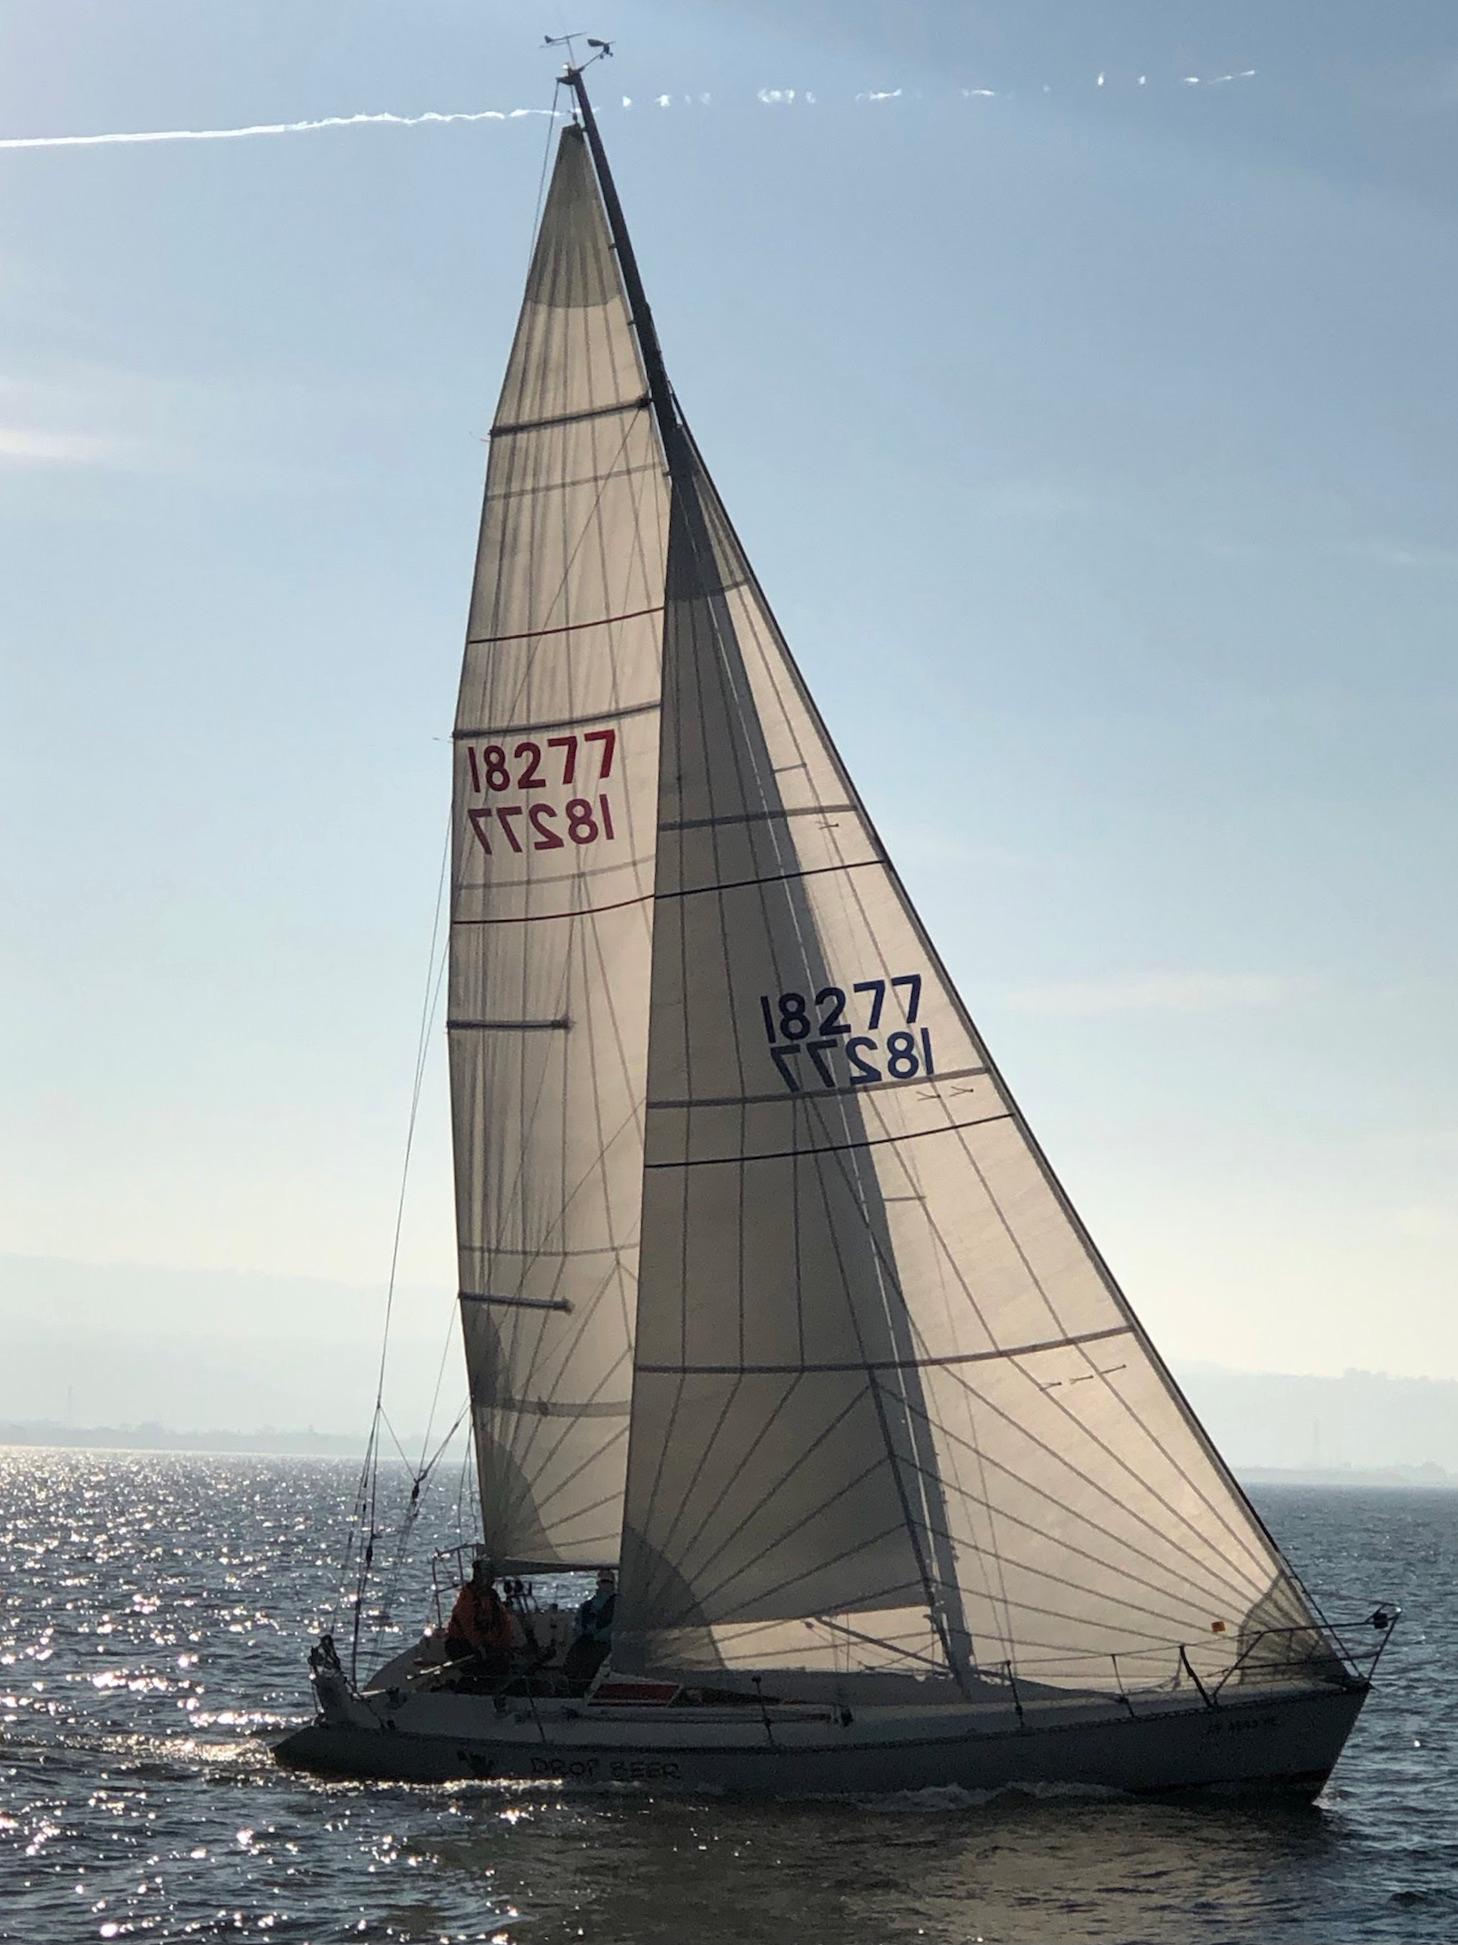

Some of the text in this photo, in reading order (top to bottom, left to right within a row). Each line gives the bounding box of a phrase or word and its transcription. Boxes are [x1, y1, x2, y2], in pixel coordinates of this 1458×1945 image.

[468, 729, 616, 793] 18277
[761, 974, 922, 1043] 18277
[530, 1757, 599, 1777] DROP
